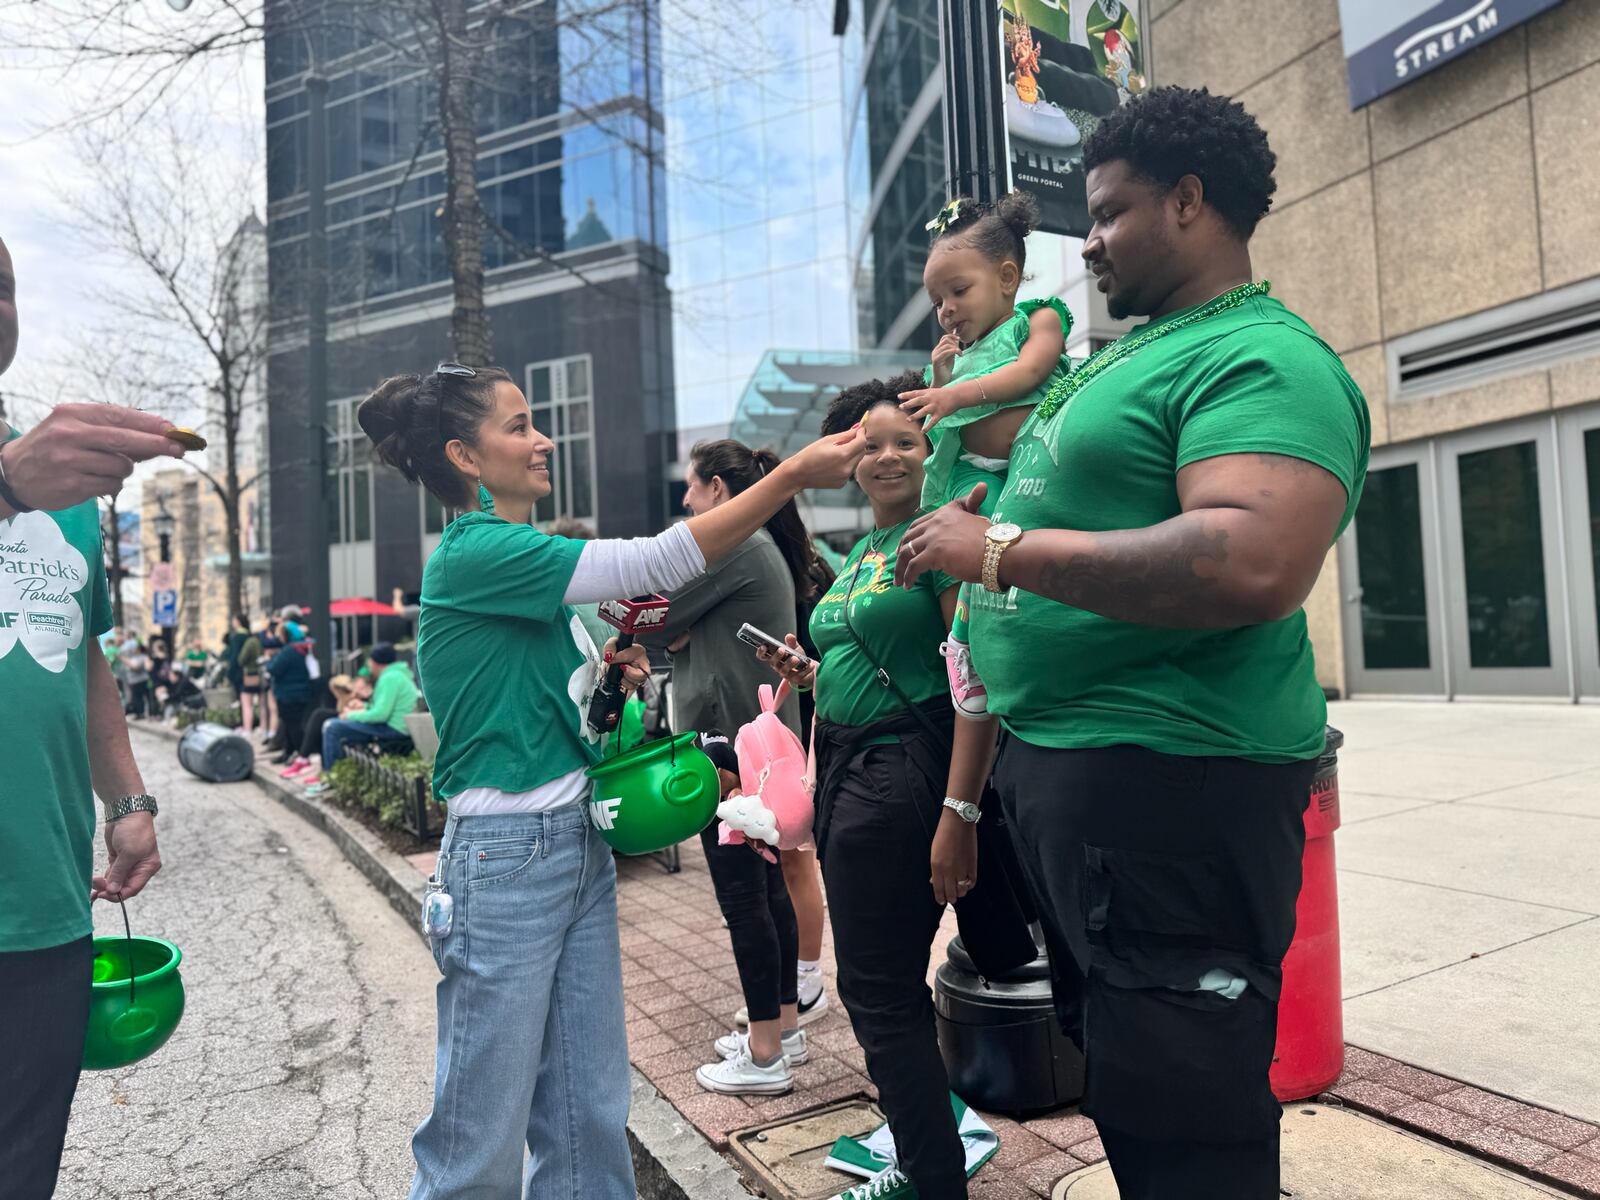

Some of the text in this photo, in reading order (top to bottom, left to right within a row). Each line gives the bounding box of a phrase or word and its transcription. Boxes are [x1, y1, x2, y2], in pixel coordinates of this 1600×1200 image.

[1395, 8, 1498, 77] STREAM
[1018, 173, 1064, 188] GREEN PORTAL
[0, 539, 28, 553] anta
[13, 577, 71, 604] Parade
[600, 600, 631, 621] ANF
[634, 607, 669, 625] ANF
[31, 615, 64, 625] Peachtree
